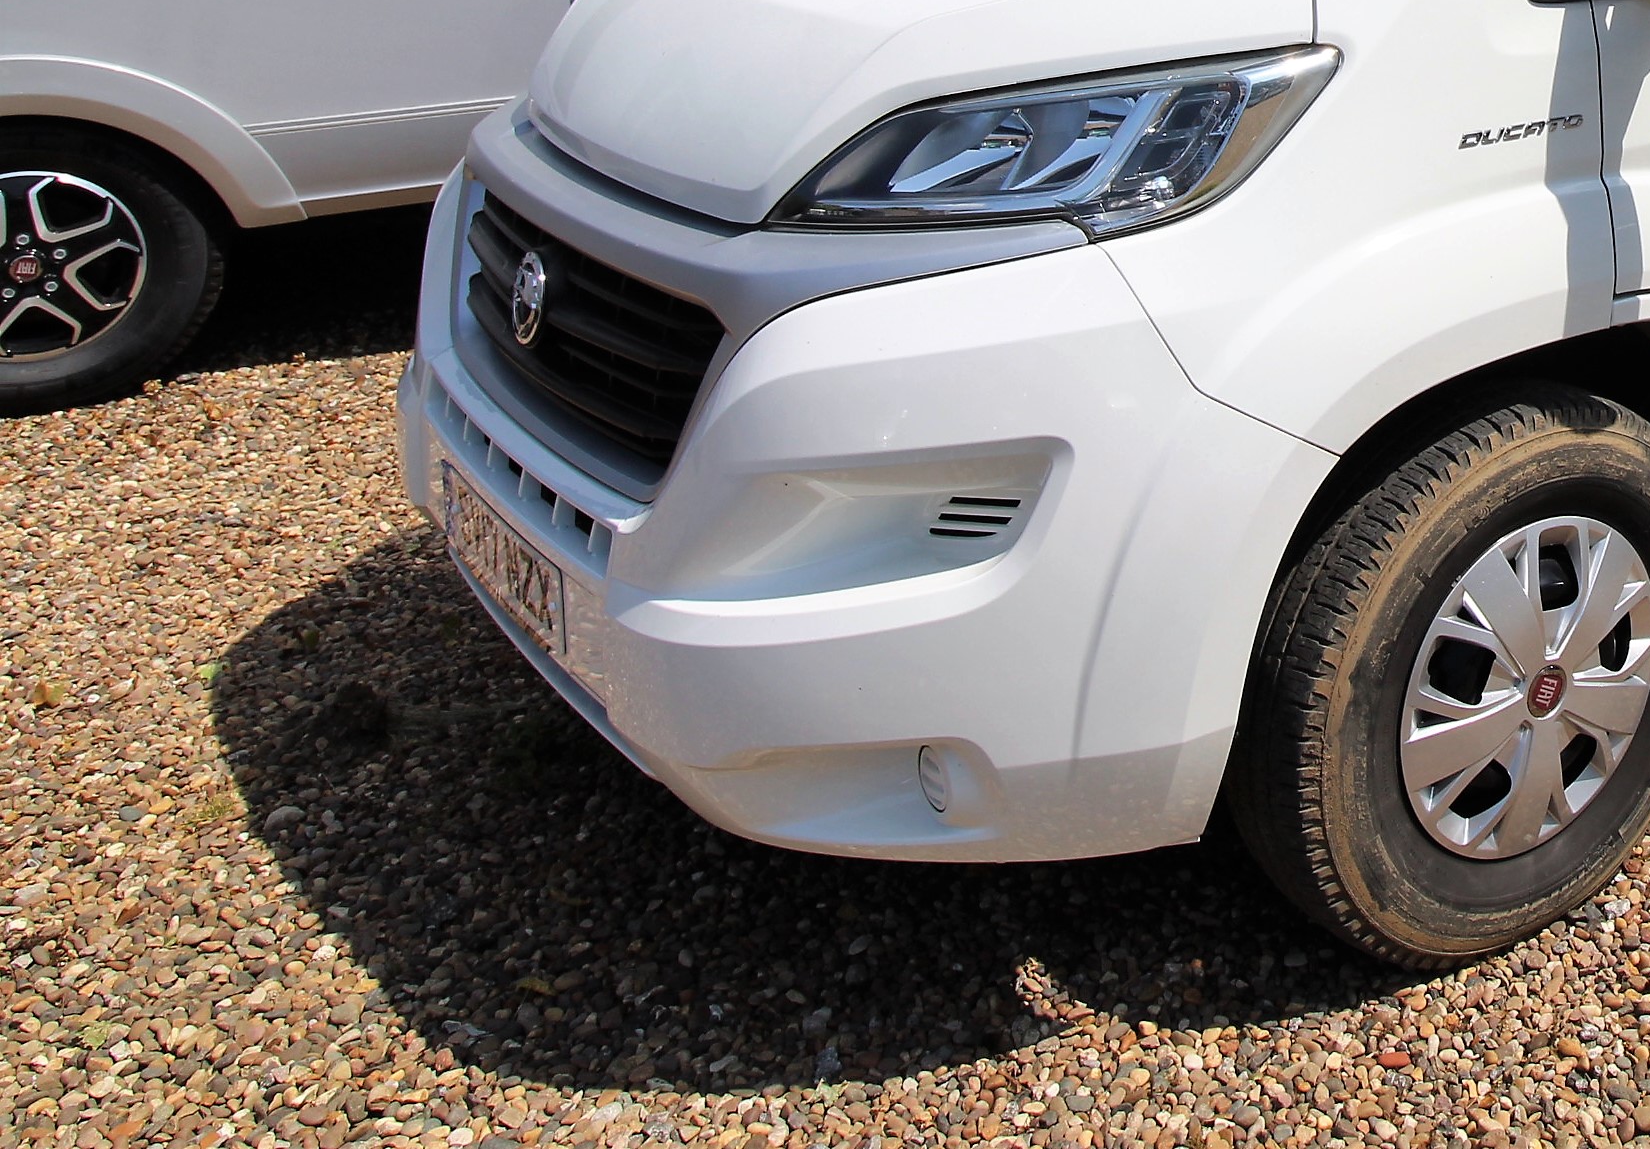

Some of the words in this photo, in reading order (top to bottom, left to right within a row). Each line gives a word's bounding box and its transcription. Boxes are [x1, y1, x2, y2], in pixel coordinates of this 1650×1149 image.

[1458, 114, 1584, 149] DUCATO
[16, 262, 37, 274] FIAT
[1536, 677, 1558, 708] FIAT
